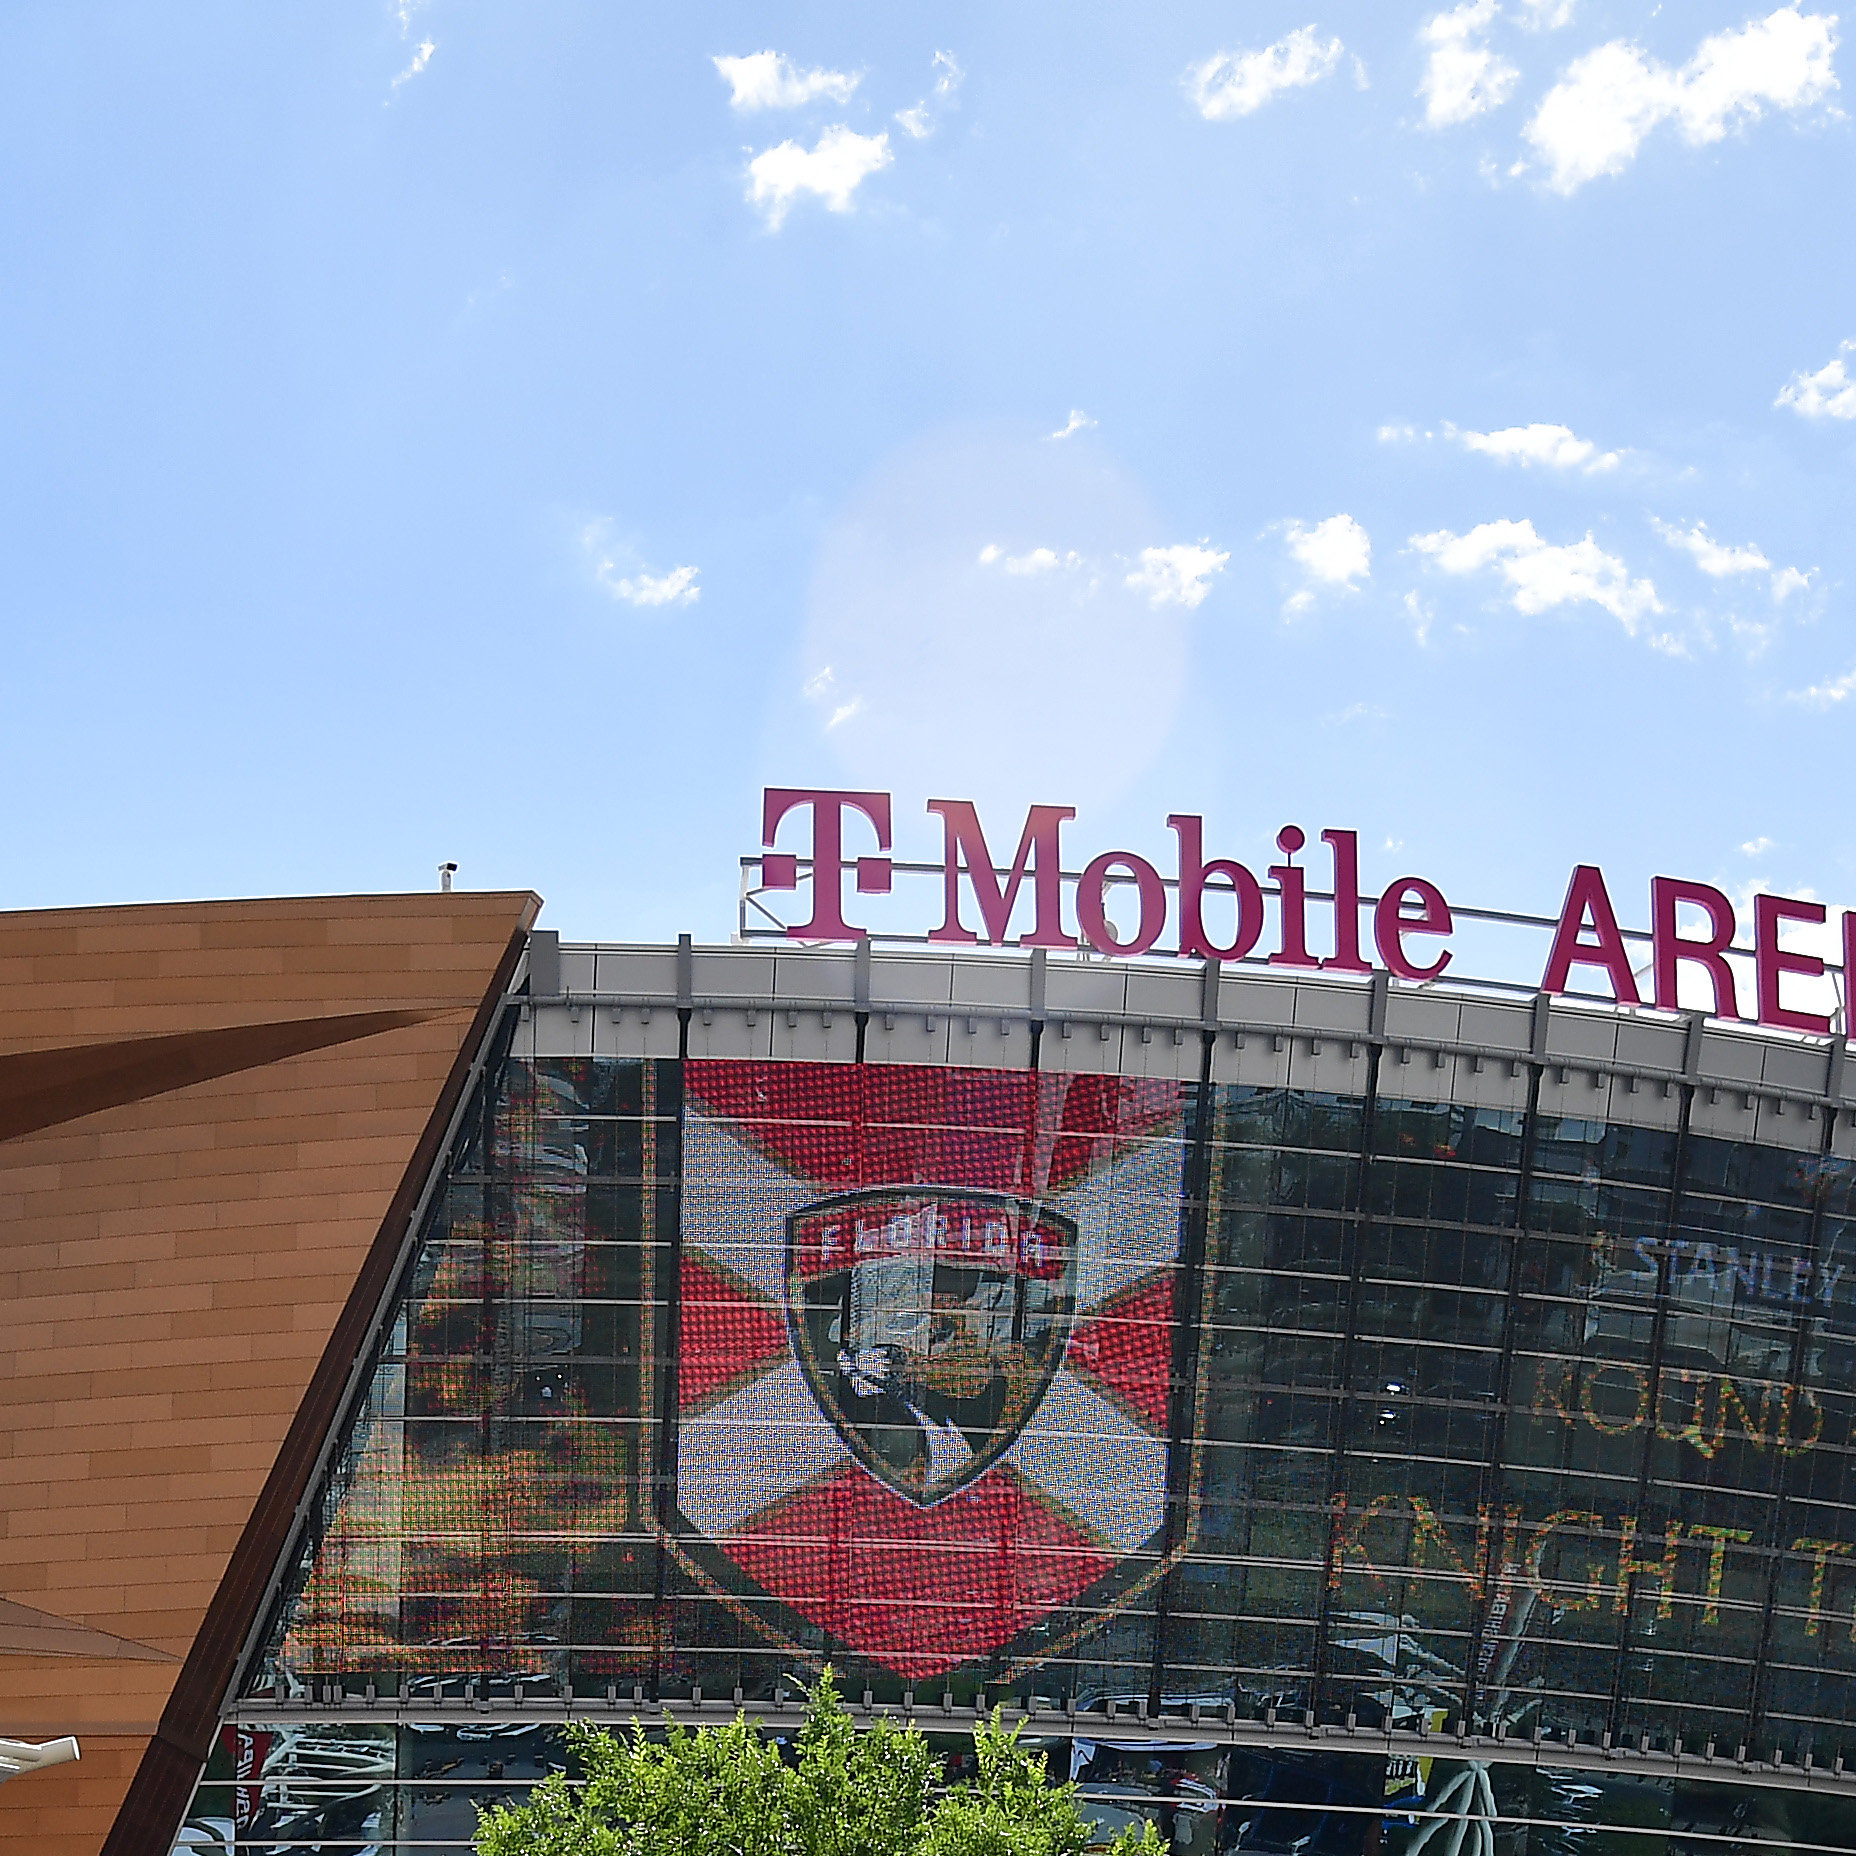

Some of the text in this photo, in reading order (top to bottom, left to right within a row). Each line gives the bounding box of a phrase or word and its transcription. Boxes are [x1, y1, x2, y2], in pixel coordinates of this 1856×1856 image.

[821, 1216, 1046, 1264] FLORIDA
[1630, 1236, 1846, 1308] STANLEY
[1532, 1358, 1823, 1459] ROUND
[1327, 1490, 1755, 1628] KNIGHT
